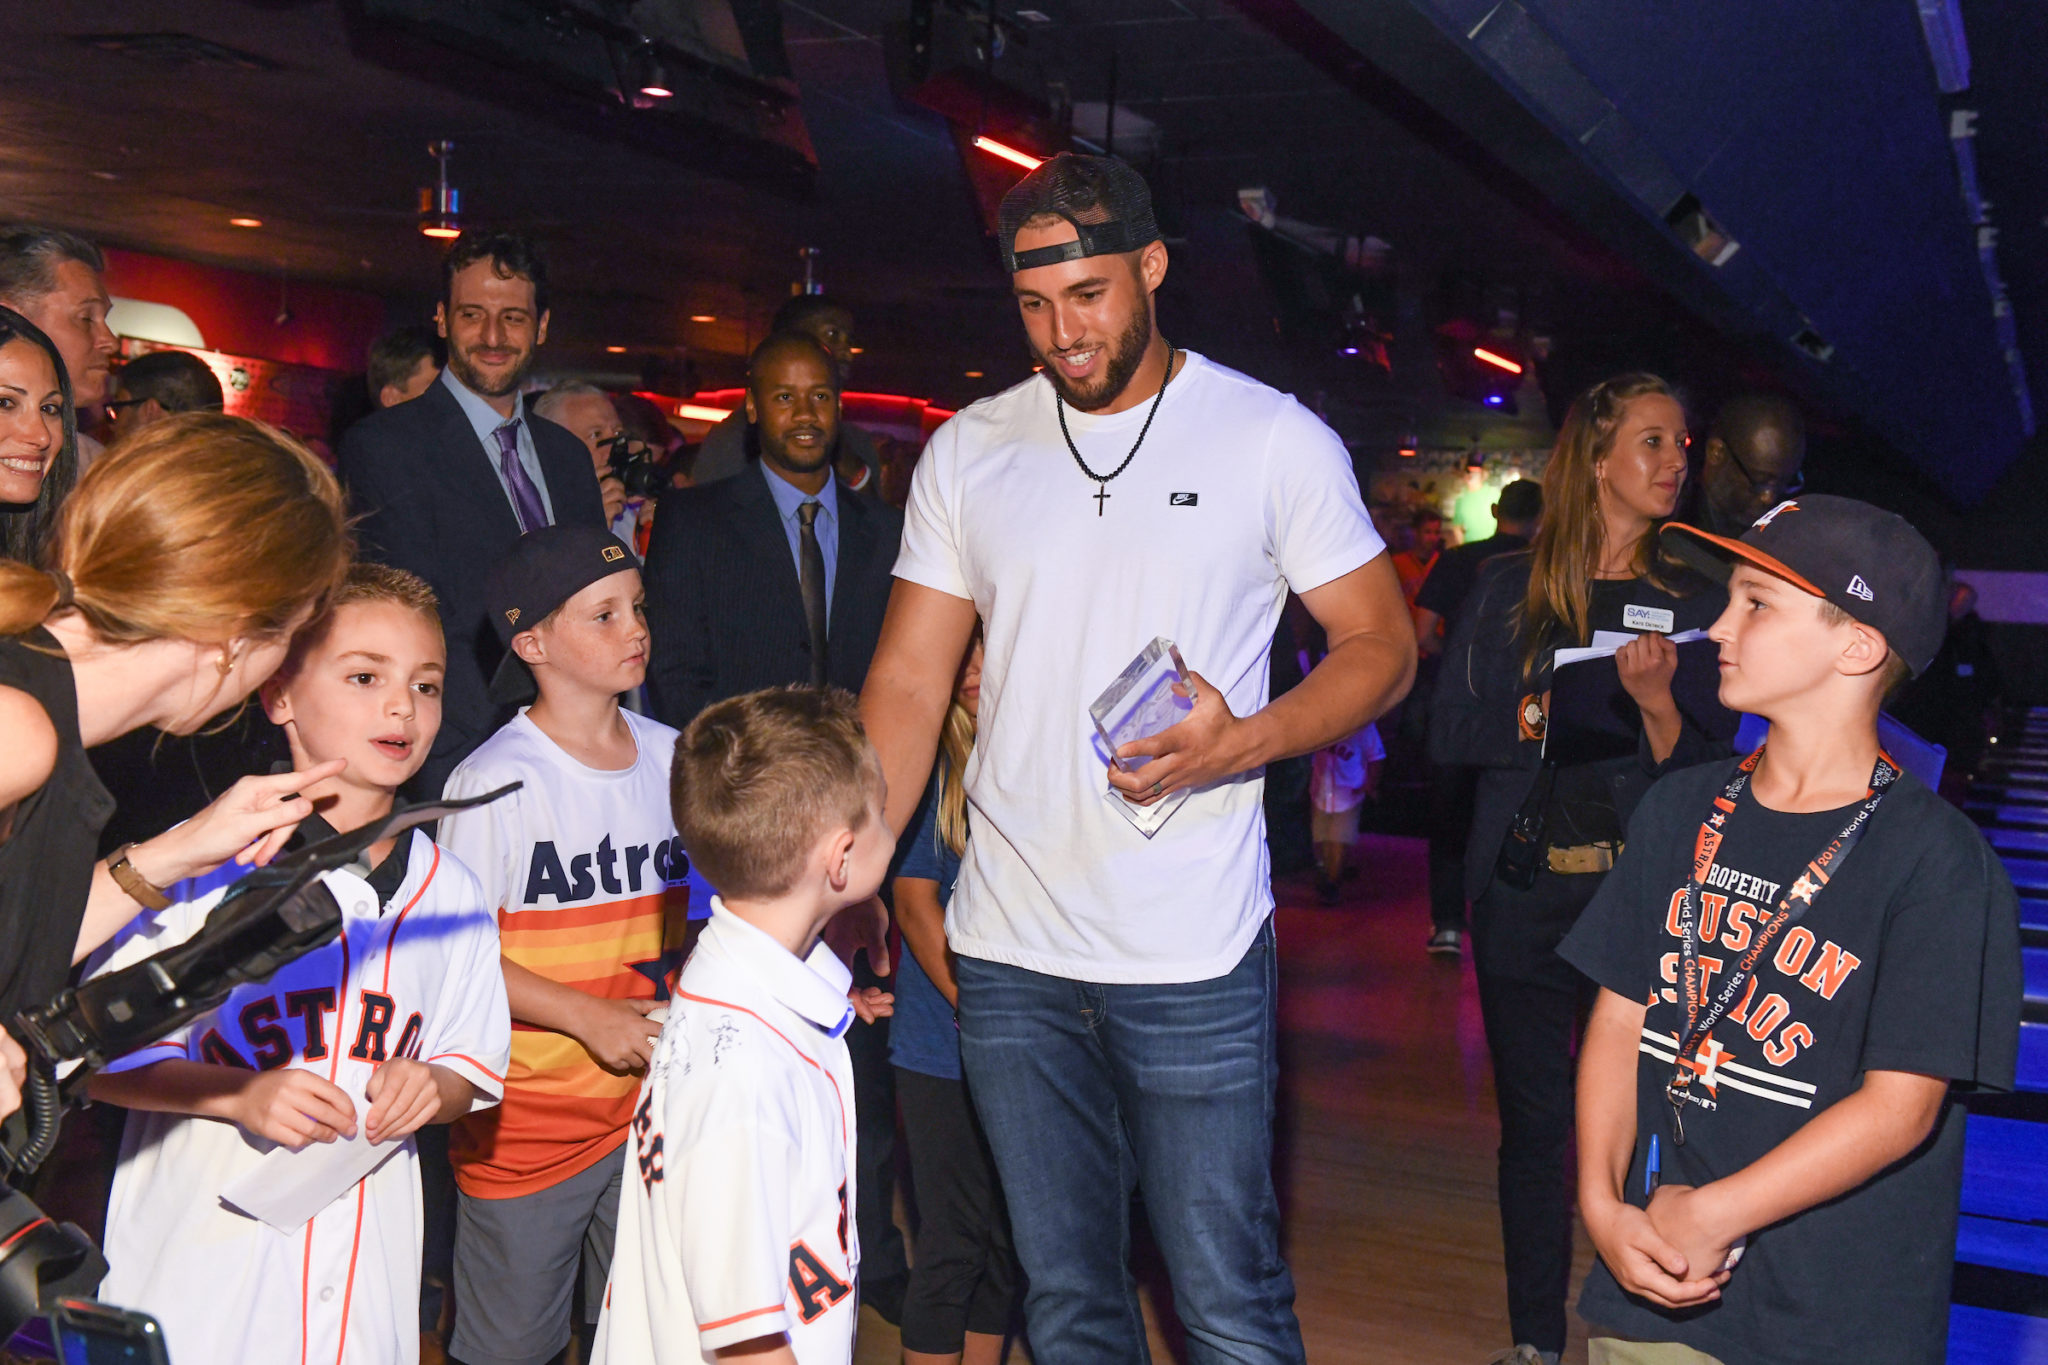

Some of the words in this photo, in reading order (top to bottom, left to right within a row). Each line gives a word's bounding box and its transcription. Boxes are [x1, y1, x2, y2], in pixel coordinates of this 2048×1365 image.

[1693, 831, 1715, 873] ASTRO
[1817, 839, 1842, 867] 2017
[1838, 810, 1869, 839] World
[1706, 862, 1781, 905] ROPERTY
[1664, 887, 1862, 1001] OUSON
[1682, 920, 1693, 957] Series
[1684, 958, 1699, 1029] CHAMPION
[1697, 1002, 1724, 1032] World
[1717, 971, 1745, 1003] Series
[1739, 910, 1790, 972] CHAMPIONS
[1656, 951, 1815, 1067] STOS
